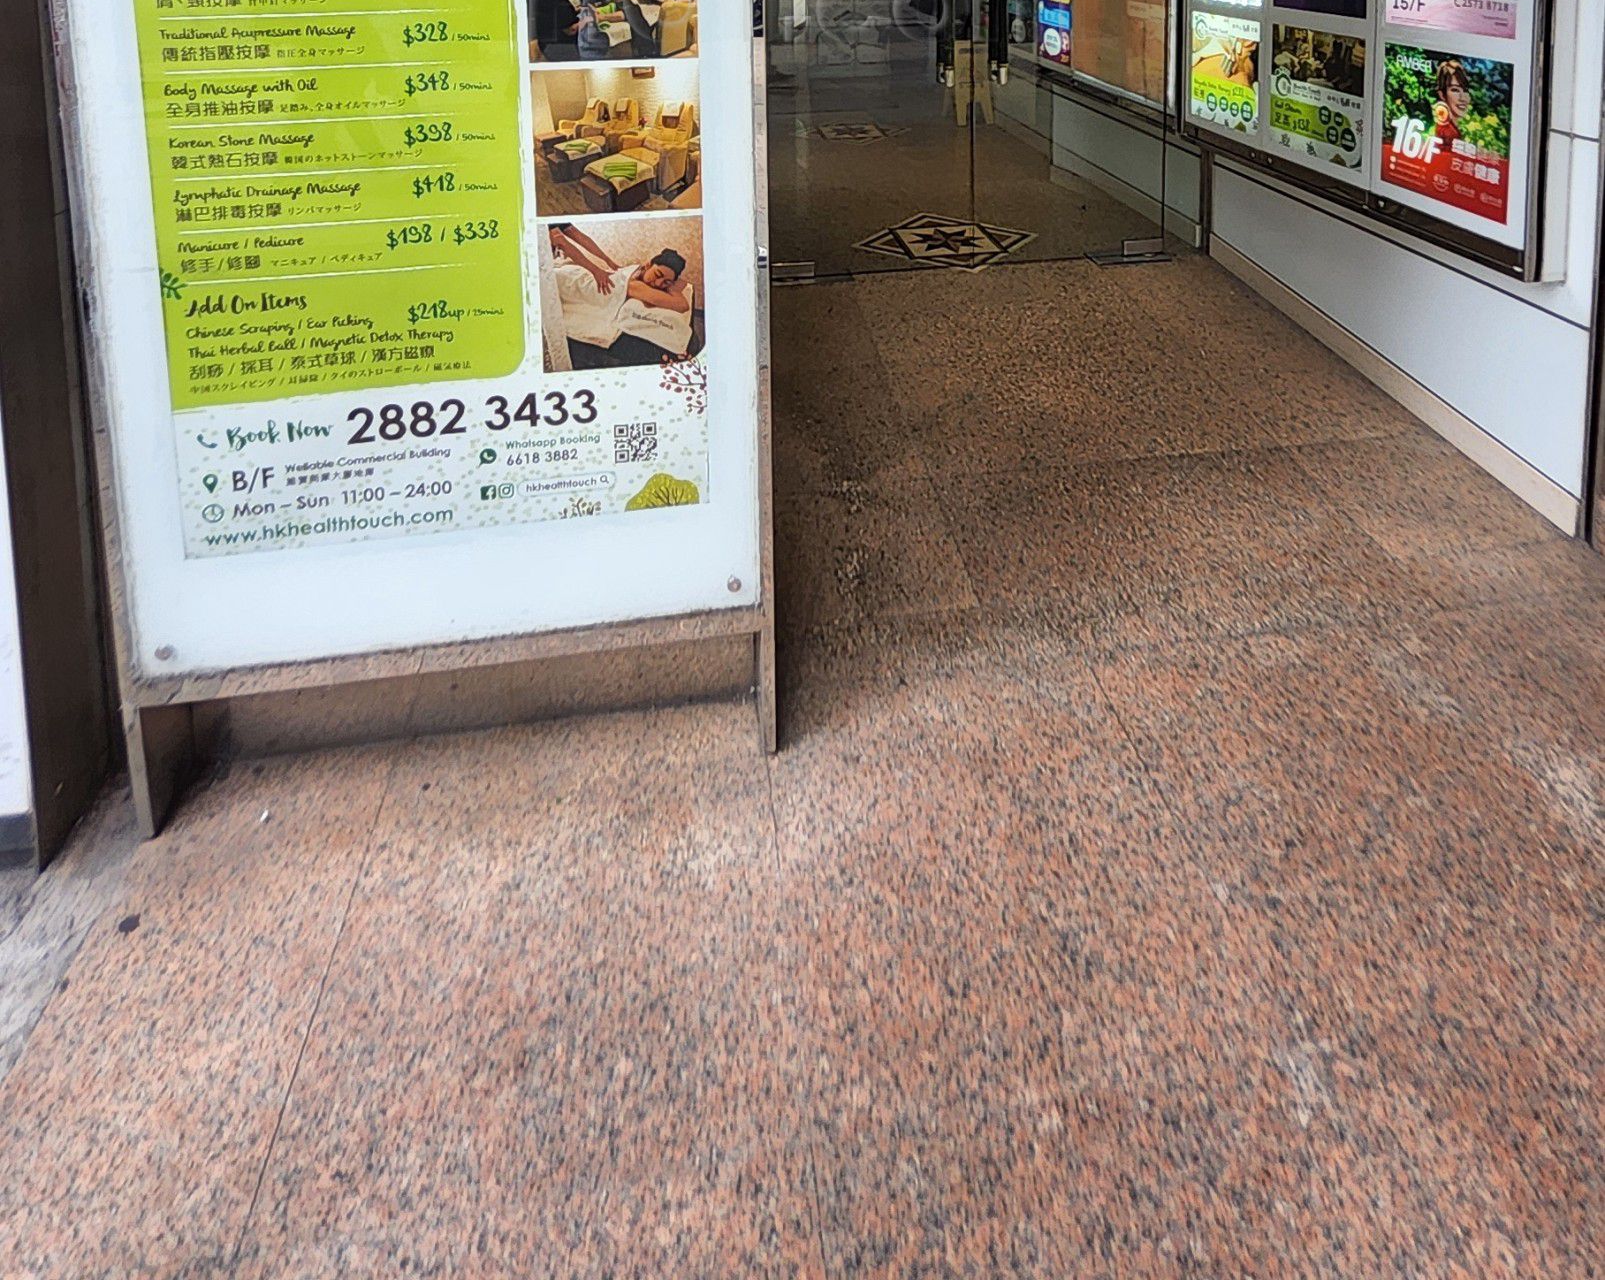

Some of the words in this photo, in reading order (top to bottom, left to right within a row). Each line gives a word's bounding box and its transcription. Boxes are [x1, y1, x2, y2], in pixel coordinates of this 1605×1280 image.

[158, 26, 228, 41] Traditional
[305, 25, 357, 41] Massage
[402, 21, 448, 48] $328
[163, 83, 197, 101] Body
[201, 80, 259, 98] Massage
[262, 78, 295, 93] with
[297, 77, 319, 92] Oil
[404, 70, 450, 97] $348
[165, 98, 274, 119] 全身推油按摩
[168, 136, 216, 150] Korean
[218, 134, 255, 148] Stone
[258, 132, 316, 149] Massage
[403, 121, 453, 149] $398
[173, 186, 242, 207] Lymphatic
[246, 184, 303, 201] Drainage
[306, 181, 362, 197] Massage
[412, 172, 456, 199] $418
[177, 239, 240, 254] Manicure
[253, 235, 305, 249] Pedicure
[386, 223, 433, 251] $198
[453, 219, 500, 246] $338
[184, 293, 228, 318] Add
[231, 294, 257, 315] On
[260, 292, 308, 313] Items
[186, 325, 236, 340] Chinese
[240, 320, 296, 337] Scraping
[331, 314, 374, 330] Picking
[188, 346, 216, 359] Thai
[219, 340, 265, 356] Herbal
[309, 333, 366, 351] Magnetic
[369, 331, 404, 344] Detox
[406, 328, 454, 343] Therapy
[226, 420, 281, 451] Book
[286, 421, 334, 443] Now
[346, 398, 467, 446] 2882
[484, 388, 598, 432] 3433
[505, 438, 557, 450] Whatsapp
[559, 433, 602, 446] Booking
[336, 451, 406, 468] Commercial
[409, 447, 452, 459] Building
[506, 452, 541, 467] 6618
[544, 448, 579, 463] 3882
[232, 466, 276, 496] B/F
[525, 477, 598, 494] hkhealthtouch
[232, 501, 276, 520] Mon
[296, 494, 330, 510] Sun
[341, 486, 386, 505] 11:00
[404, 479, 453, 500] 24:00
[202, 507, 454, 547] www.hkhealthtouch.com
